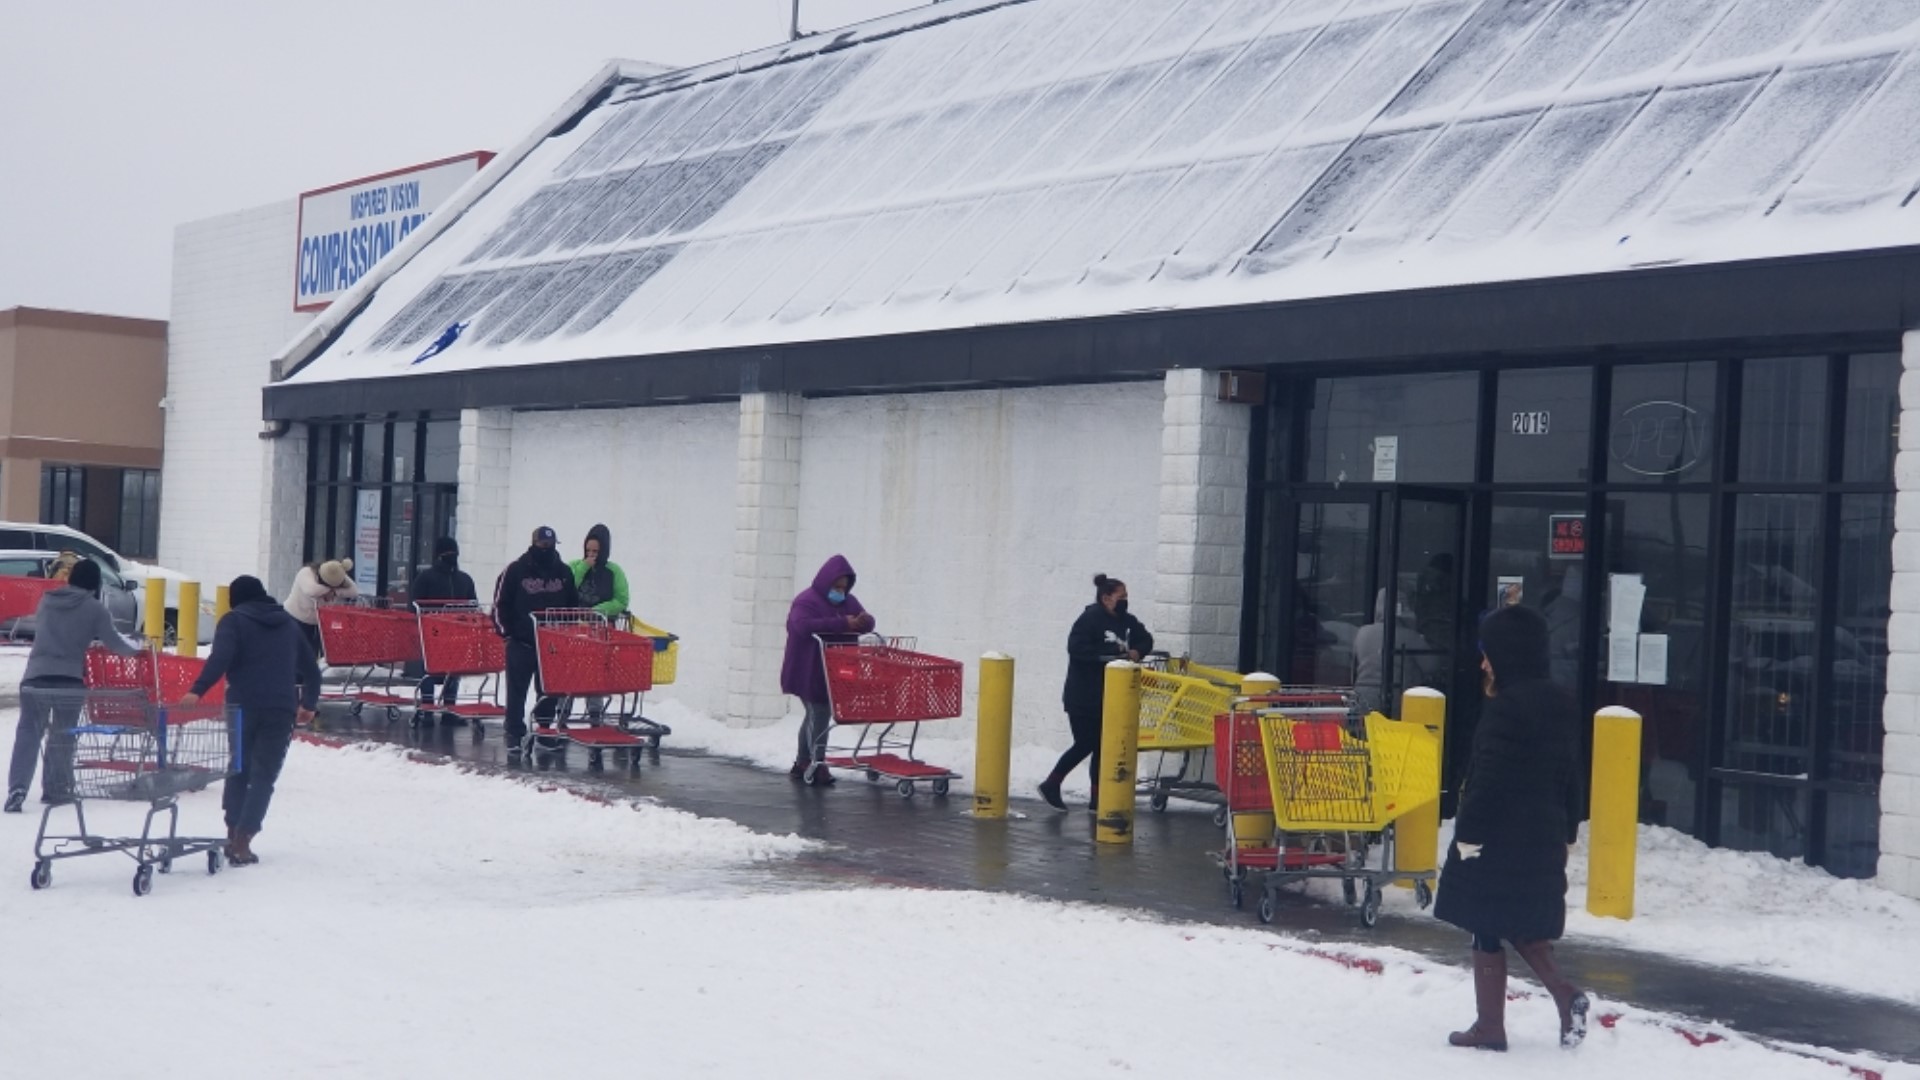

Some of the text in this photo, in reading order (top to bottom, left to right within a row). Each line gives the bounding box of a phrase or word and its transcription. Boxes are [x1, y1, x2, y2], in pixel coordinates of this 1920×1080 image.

[351, 180, 419, 220] INSPIRED VISION
[1513, 412, 1549, 434] 2019
[1609, 416, 1706, 461] OPEN
